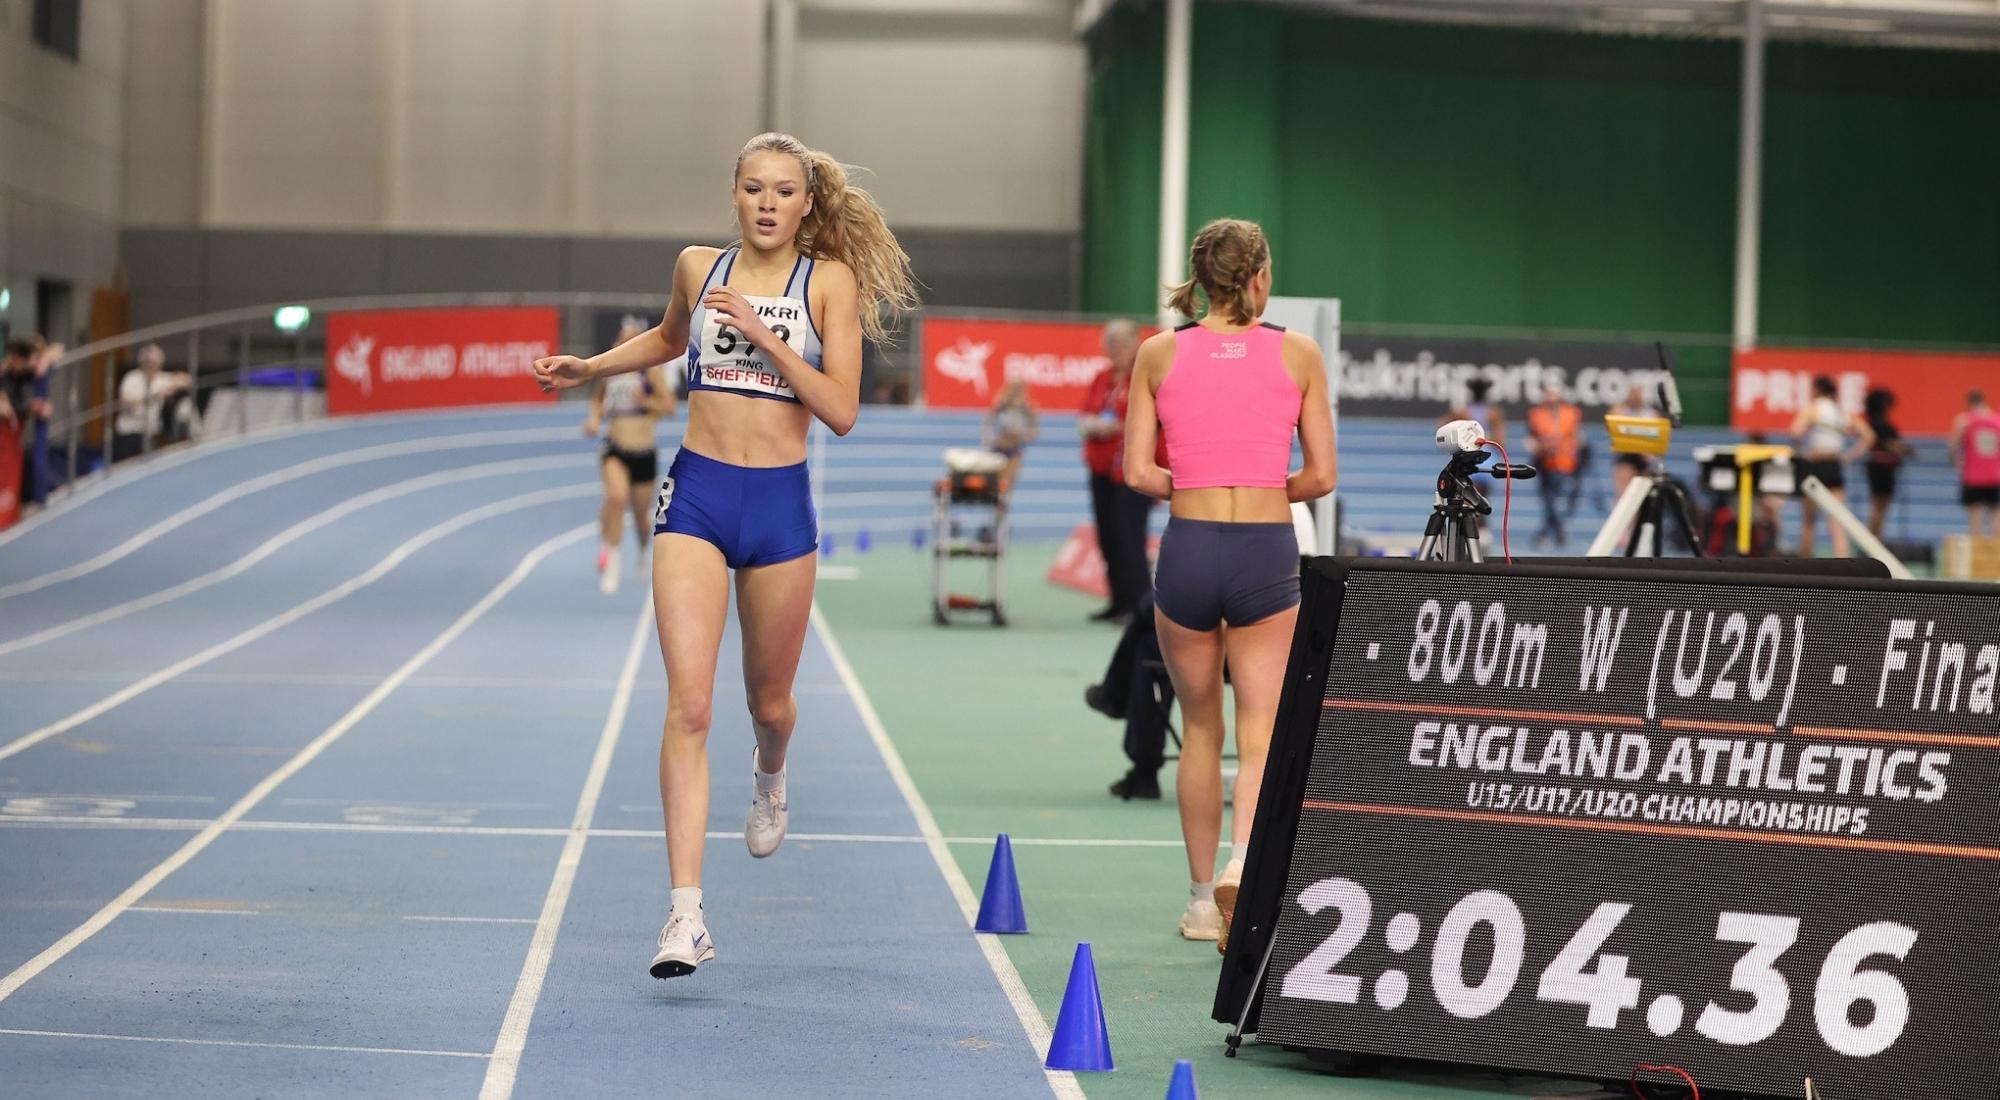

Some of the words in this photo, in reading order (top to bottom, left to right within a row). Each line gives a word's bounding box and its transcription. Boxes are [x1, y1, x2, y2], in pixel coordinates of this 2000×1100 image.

[749, 305, 799, 320] UKRI
[706, 366, 790, 389] SHEFFIELD
[735, 359, 764, 371] KING
[1735, 368, 1869, 414] PRIE
[1407, 599, 1547, 688] 800m
[1579, 605, 1628, 692] W
[1647, 609, 1805, 727] (U20)
[1408, 721, 1651, 783] ENGLAND
[1656, 736, 1951, 803] ATHLETICS
[1466, 783, 1635, 818] U15/U17/U20
[1641, 792, 1869, 835] CHAMPIONSHIPS
[1280, 876, 1919, 1058] 2:04.36
